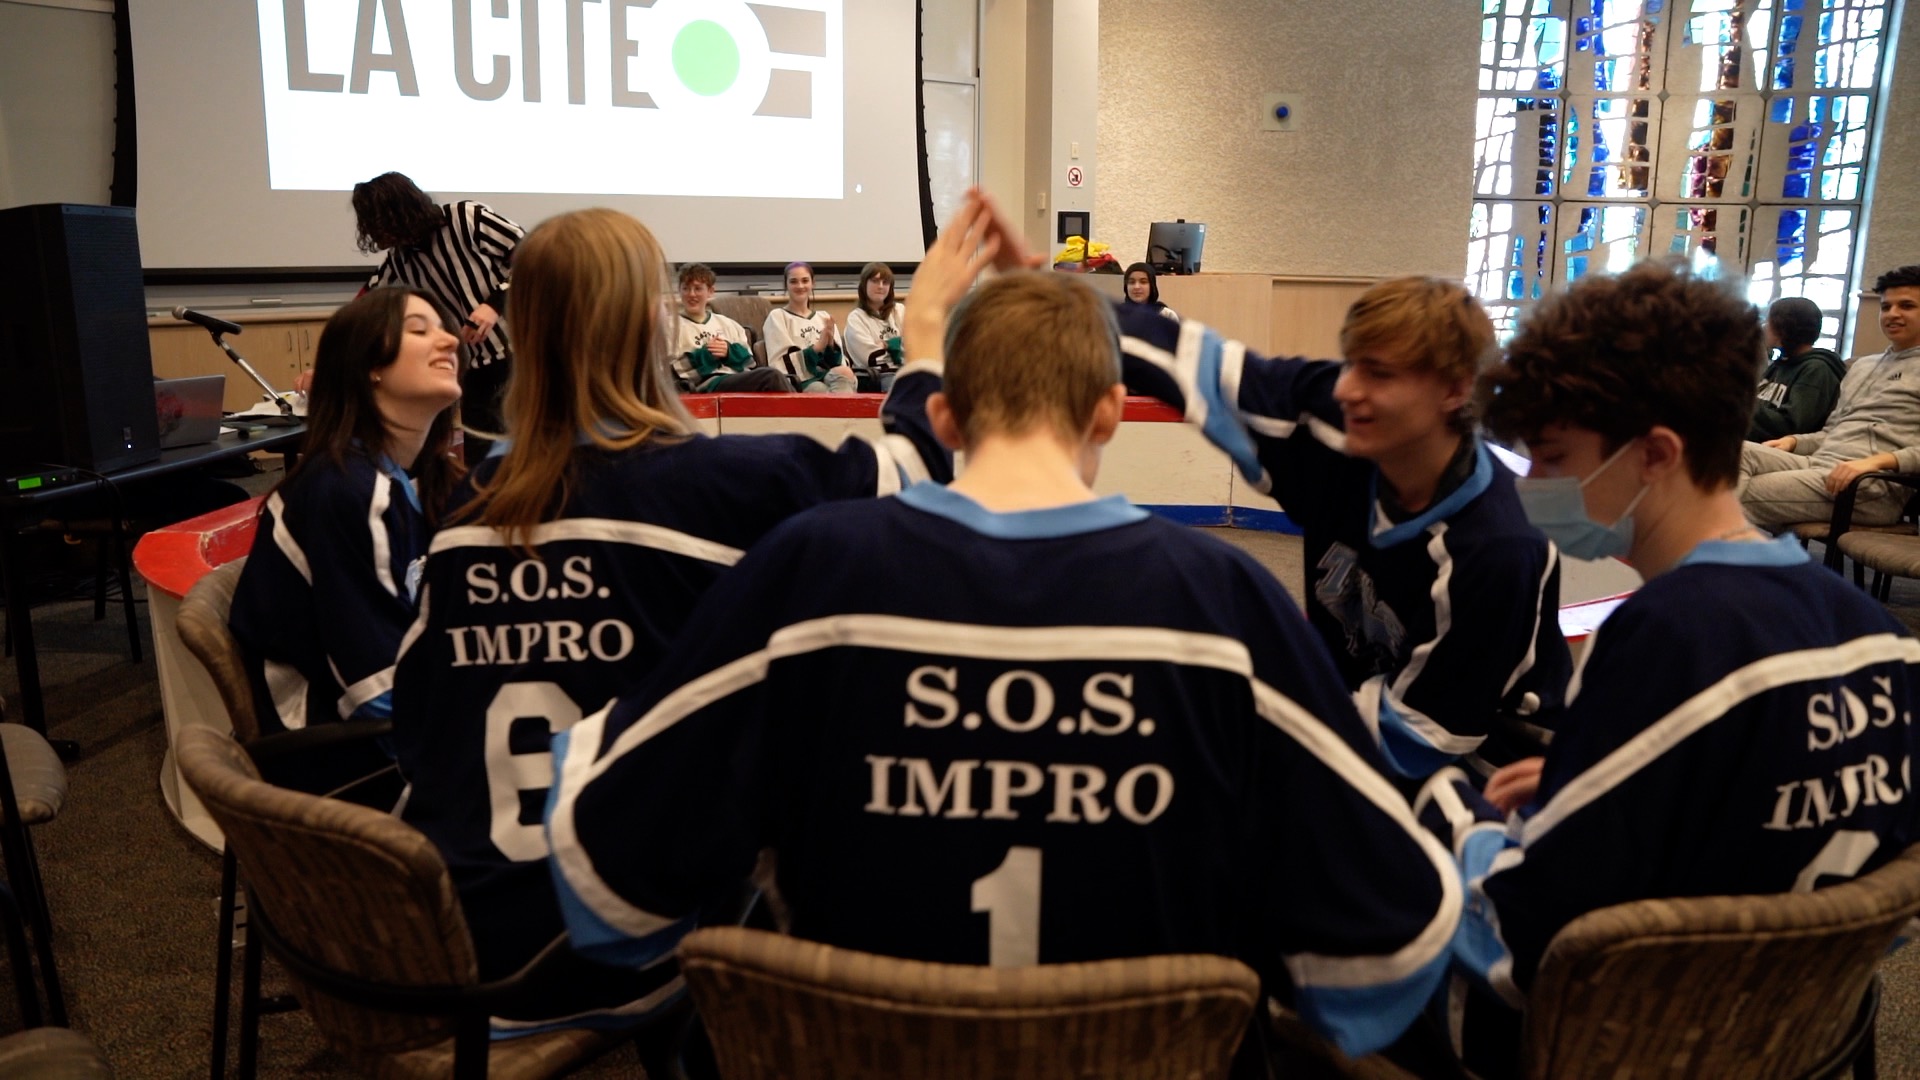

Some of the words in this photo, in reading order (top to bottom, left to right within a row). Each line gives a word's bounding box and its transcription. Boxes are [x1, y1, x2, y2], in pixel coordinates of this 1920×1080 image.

[282, 0, 420, 97] LA
[465, 556, 611, 605] S.O.S.
[446, 618, 634, 667] IMPRO
[904, 665, 1156, 737] S.O.S.
[864, 754, 1175, 825] IMPRO
[971, 846, 1042, 967] 1
